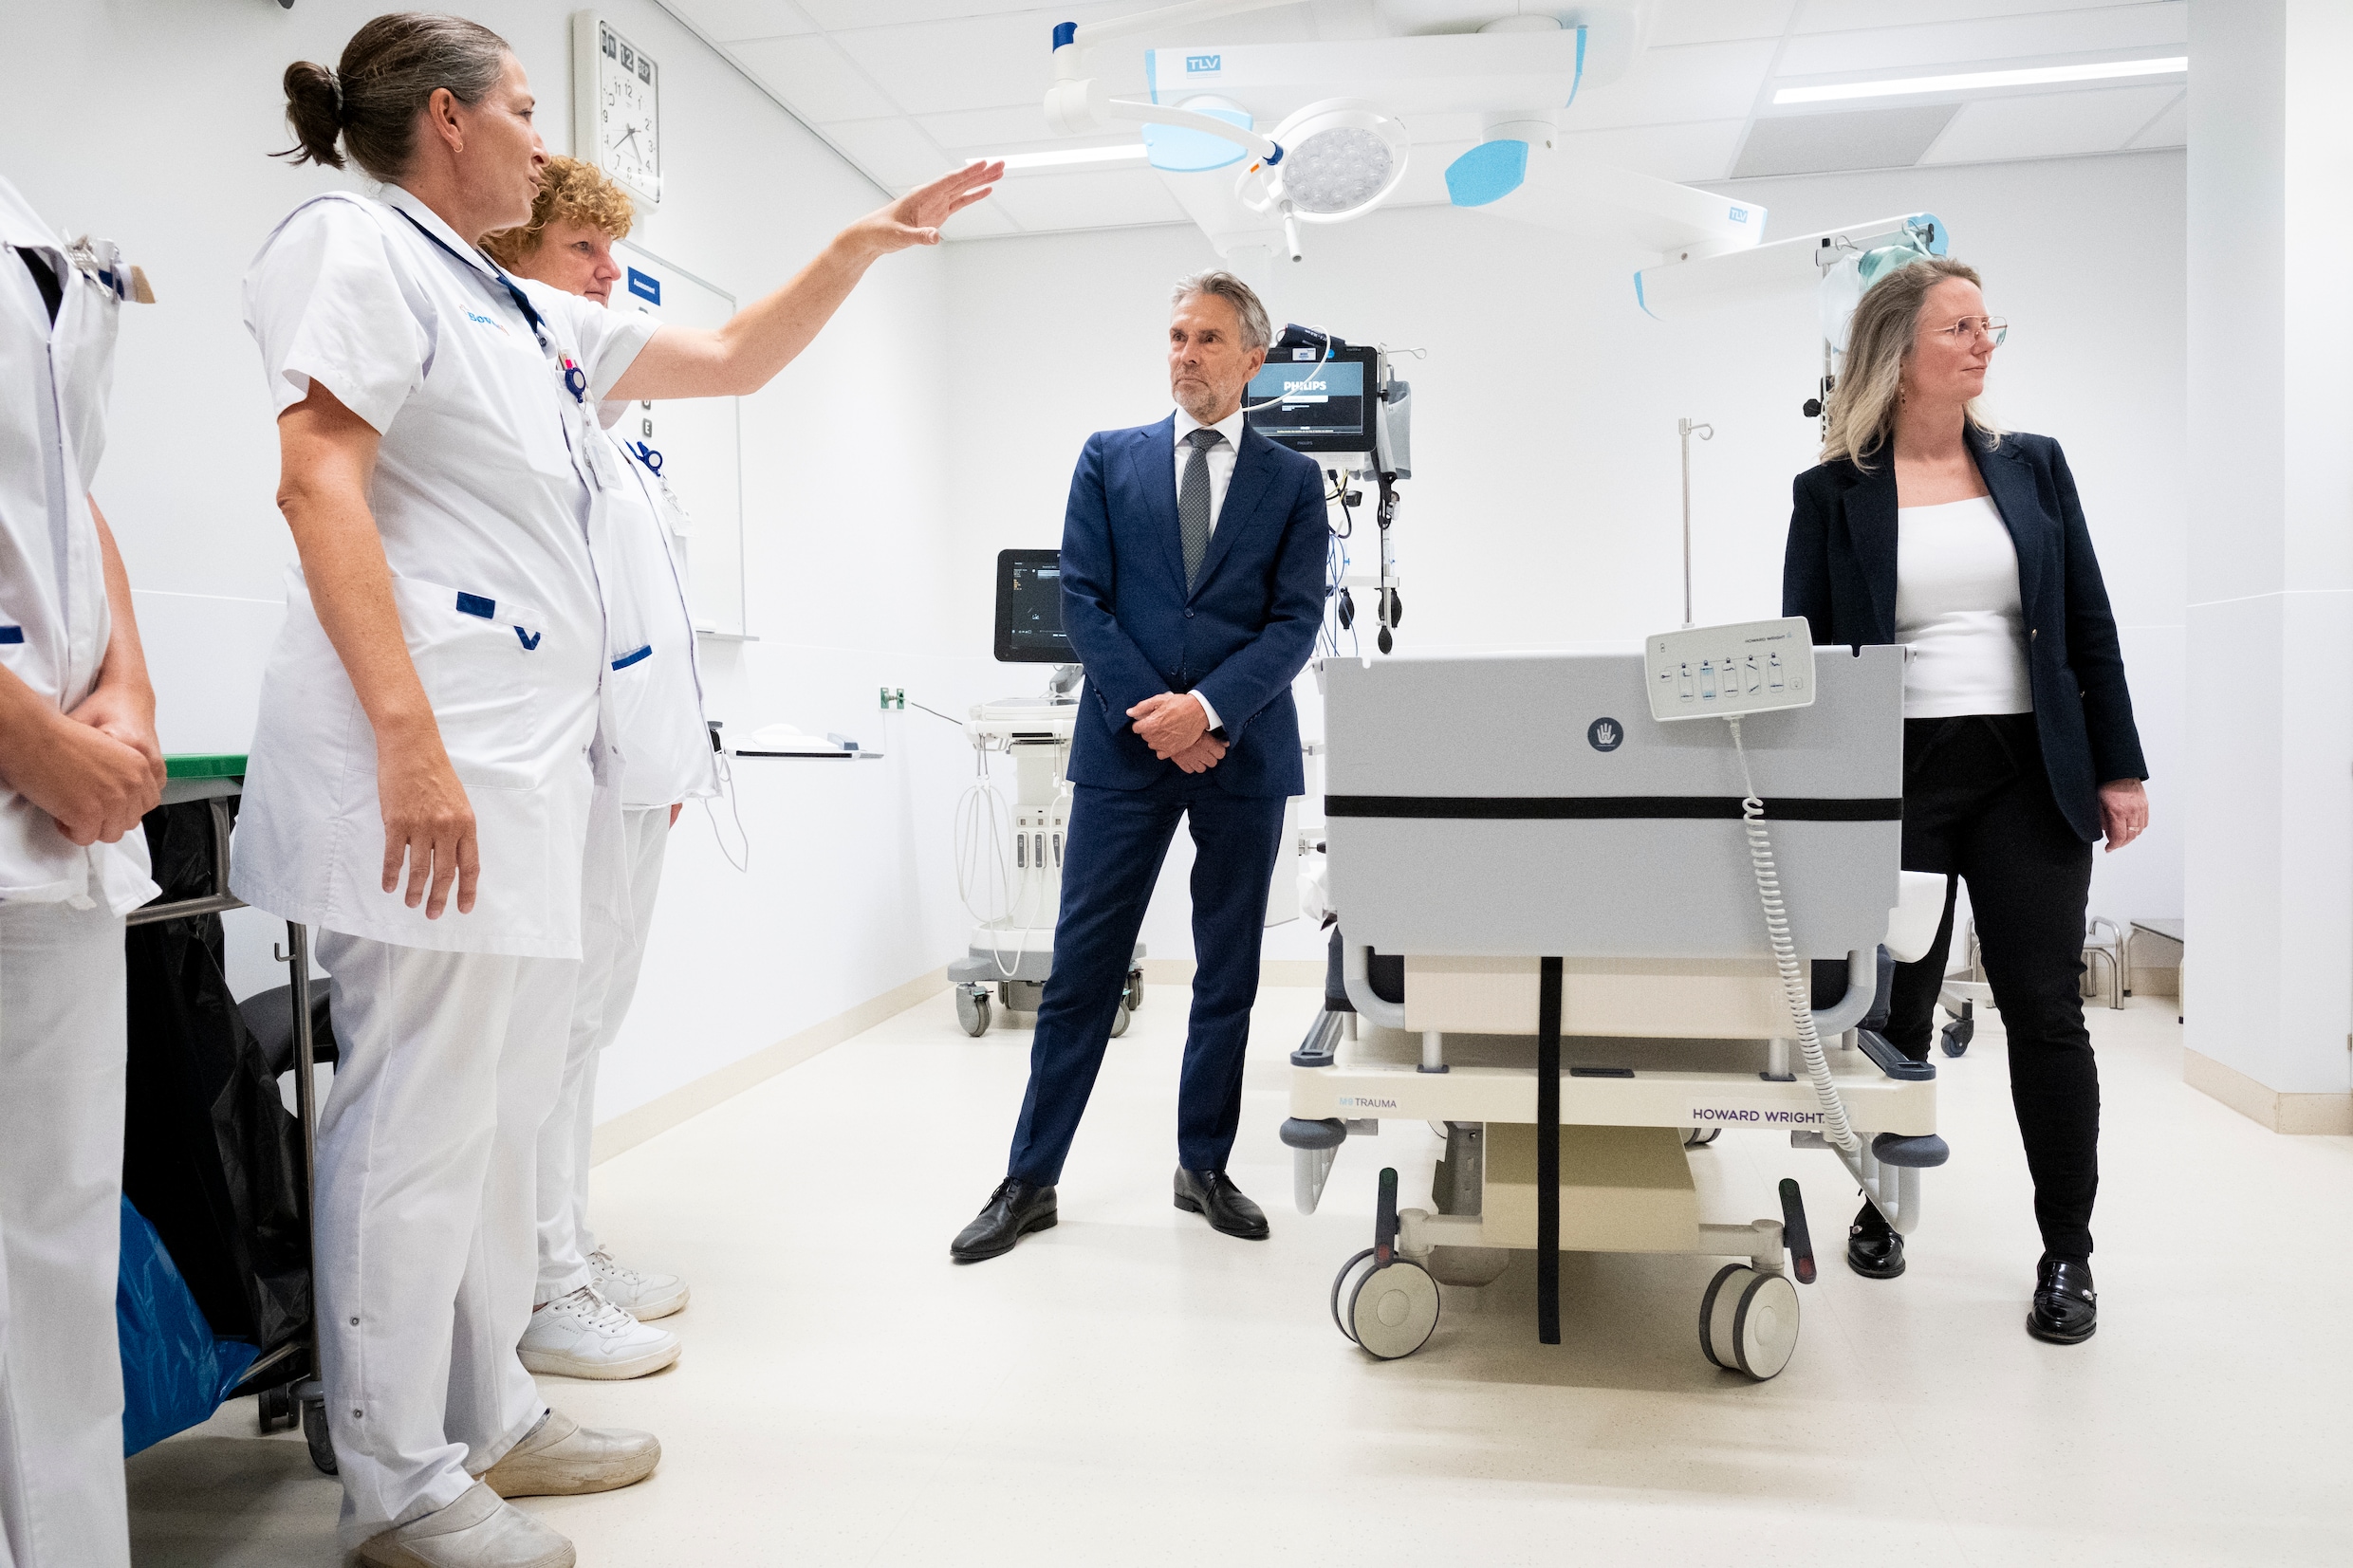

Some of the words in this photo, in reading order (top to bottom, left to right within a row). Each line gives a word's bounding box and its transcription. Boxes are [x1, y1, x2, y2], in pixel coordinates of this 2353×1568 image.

[621, 45, 633, 70] 12
[1188, 58, 1219, 70] TLV
[624, 83, 633, 99] 12
[1731, 208, 1748, 222] TLV
[1284, 381, 1327, 391] PHILIPS
[1355, 1098, 1397, 1108] TRAUMA
[1693, 1108, 1760, 1121] HOWARD
